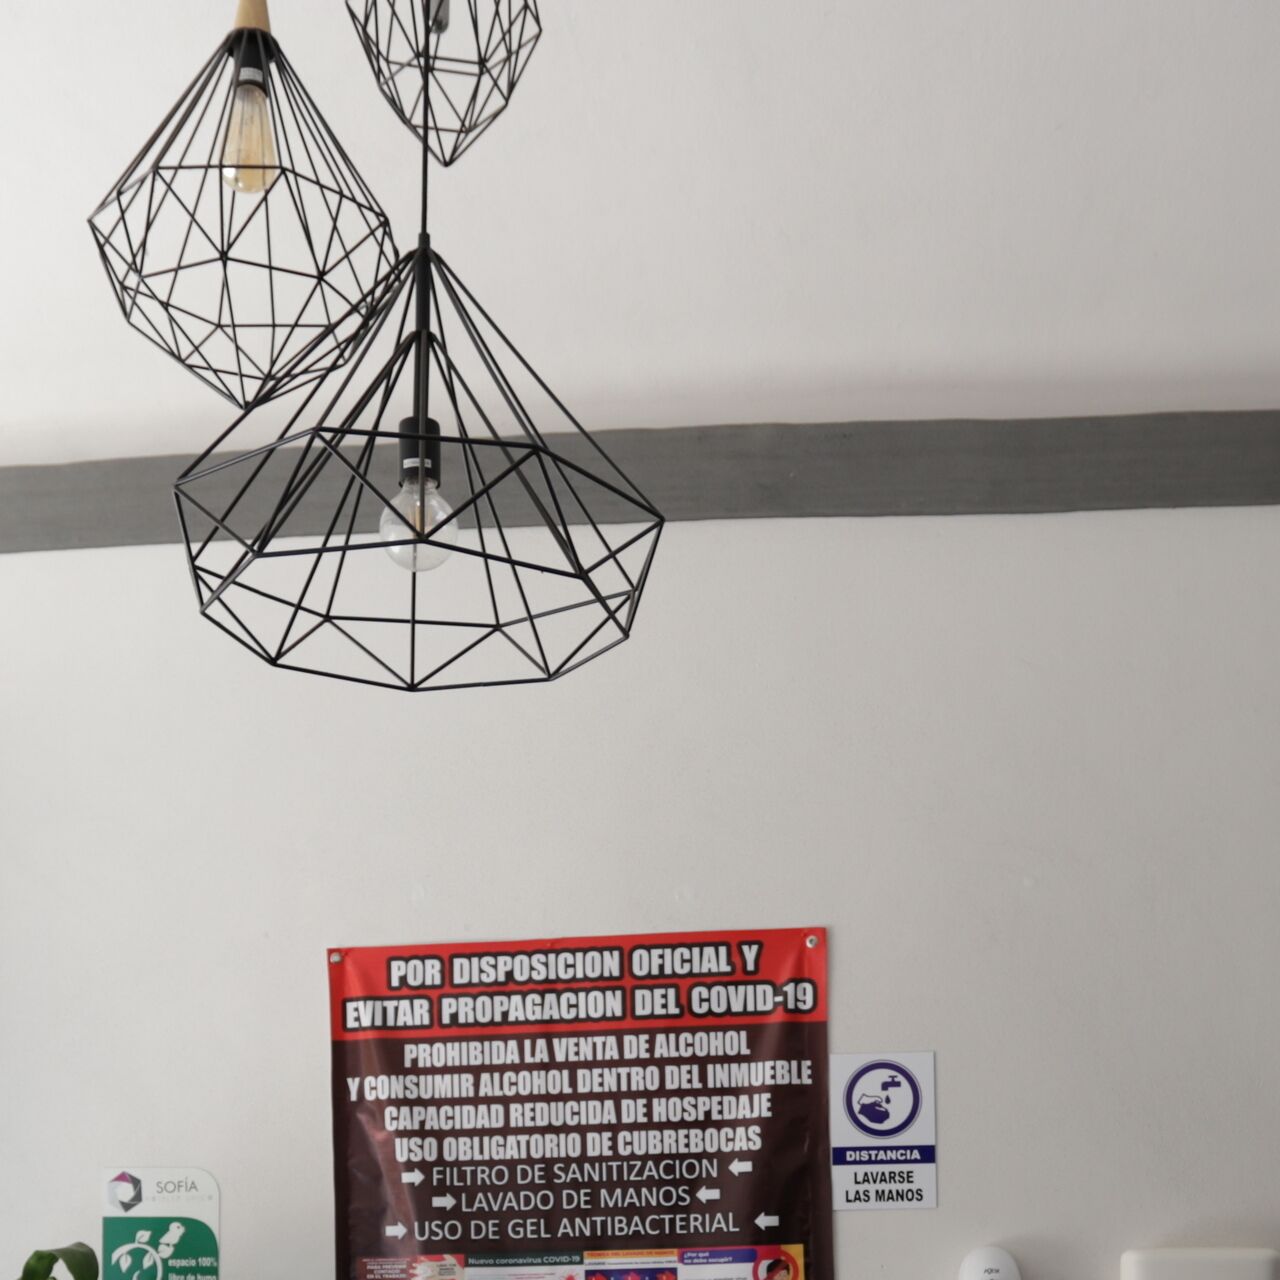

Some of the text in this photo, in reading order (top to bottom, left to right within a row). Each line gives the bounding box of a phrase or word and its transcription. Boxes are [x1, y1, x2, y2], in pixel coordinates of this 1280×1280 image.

[390, 944, 759, 988] POR DISPOSICION OFICIAL Y
[345, 982, 814, 1029] EVITAR PROPAGACION DEL COVID-19
[404, 1030, 751, 1068] PROHIBIDA LA VENTA DE ALCOHOL
[346, 1060, 813, 1101] Y CONSUMIR ALCOHOL DENTRO DEL INMUEBLE
[384, 1093, 772, 1131] CAPACIDAD REDUCIDA DE HOSPEDAJE
[394, 1125, 762, 1162] USO OBLIGATORIO DE CUBREBOCAS
[846, 1149, 921, 1161] DISTANCIA
[156, 1176, 199, 1194] SOFÍA
[432, 1159, 718, 1186] FILTRO DE SANITIZACION
[854, 1171, 914, 1185] LAVARSE
[461, 1186, 691, 1212] LAVADO DE MANOS
[845, 1188, 924, 1203] LAS MANOS
[414, 1212, 740, 1240] USO DE GEL ANTIBACTERIAL
[168, 1257, 196, 1269] espacio
[495, 1256, 542, 1265] coronavirus
[543, 1255, 580, 1263] COVID-19
